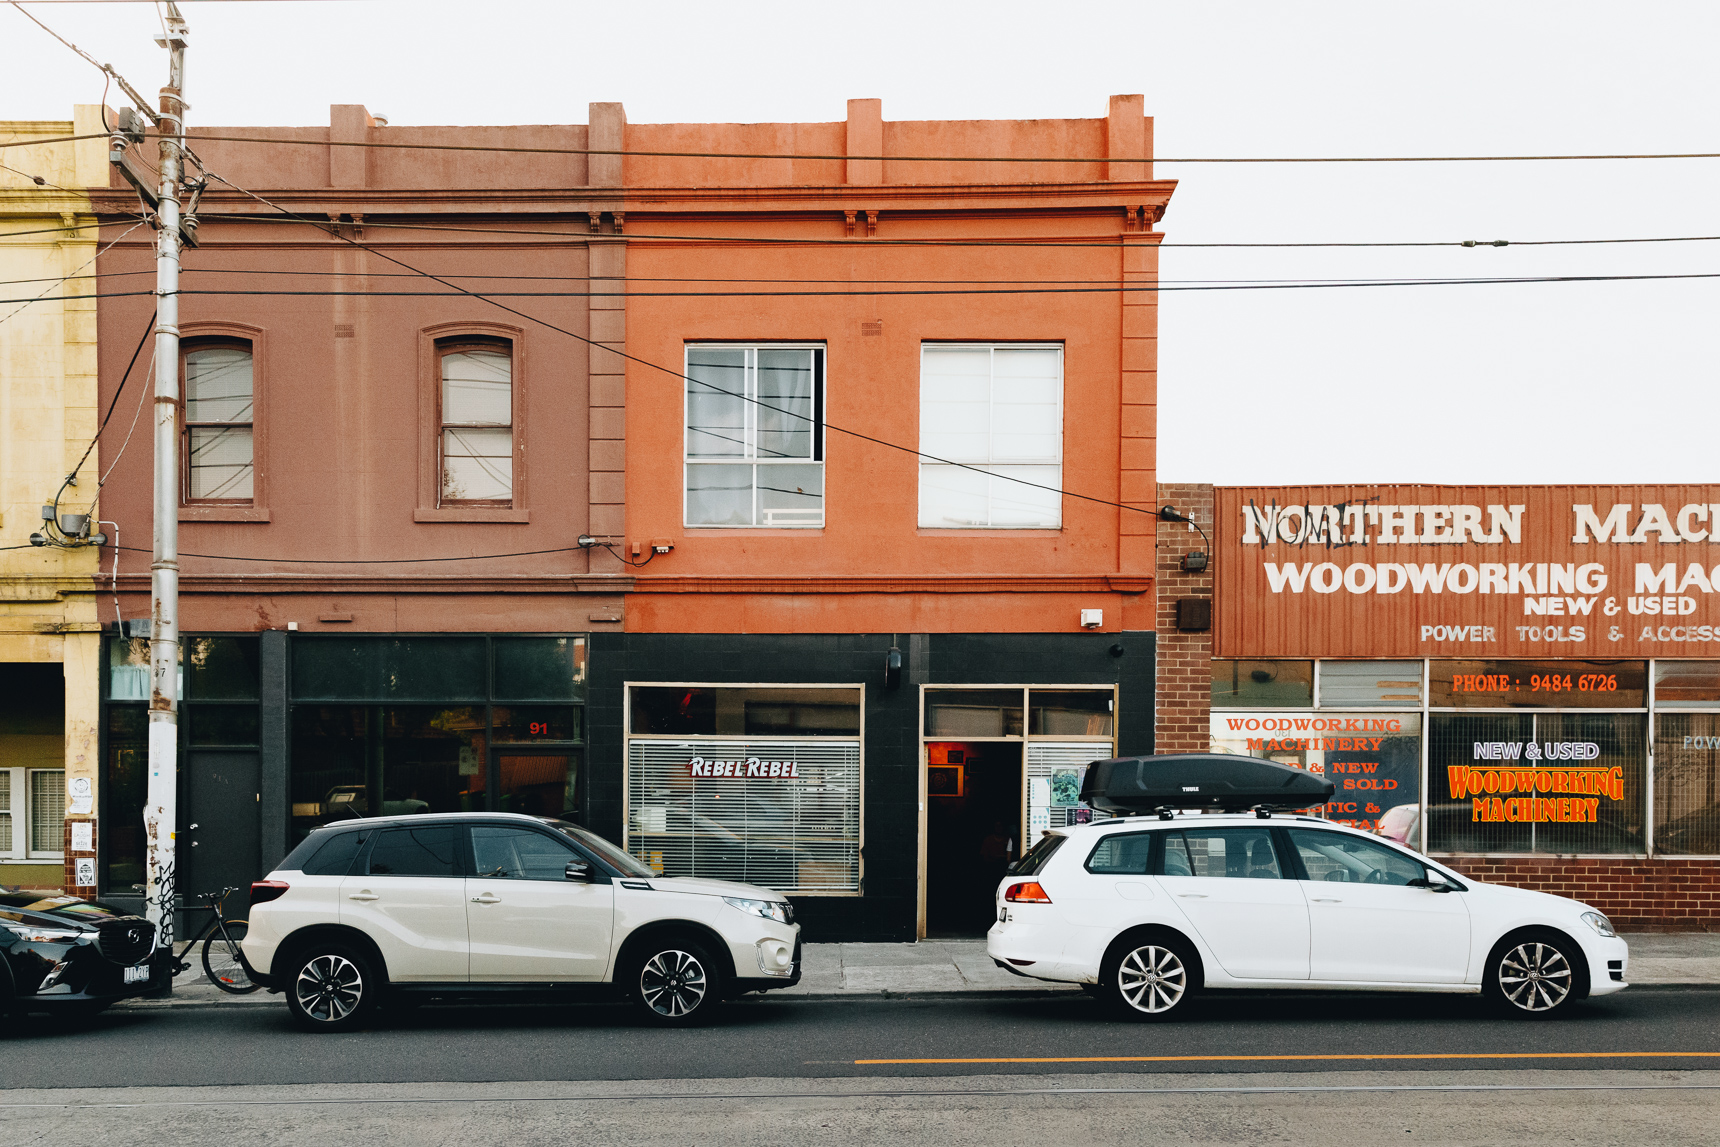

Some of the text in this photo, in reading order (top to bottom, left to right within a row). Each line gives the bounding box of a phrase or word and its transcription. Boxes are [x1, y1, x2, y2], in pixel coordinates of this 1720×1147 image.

[1242, 504, 1526, 545] NORTHERN
[1263, 562, 1608, 595] WOODWORKING
[1524, 596, 1697, 616] NEW & USED
[1421, 624, 1497, 642] POWER
[1515, 625, 1587, 643] TOOLS
[1607, 625, 1625, 642] &
[1530, 674, 1573, 692] 9484
[1578, 674, 1617, 692] 6726
[529, 722, 547, 735] 91
[1226, 718, 1401, 732] WOODWORKING
[1246, 737, 1384, 751] MACHINERY
[1473, 741, 1600, 761] NEW & USED
[686, 756, 800, 778] REBEL REBEL
[1309, 762, 1325, 773] &
[1332, 762, 1379, 774] NEW
[1343, 779, 1398, 790] SOLD
[1447, 765, 1625, 801] WOODWORKING
[1364, 802, 1381, 813] &
[1472, 797, 1600, 823] MACHINERY
